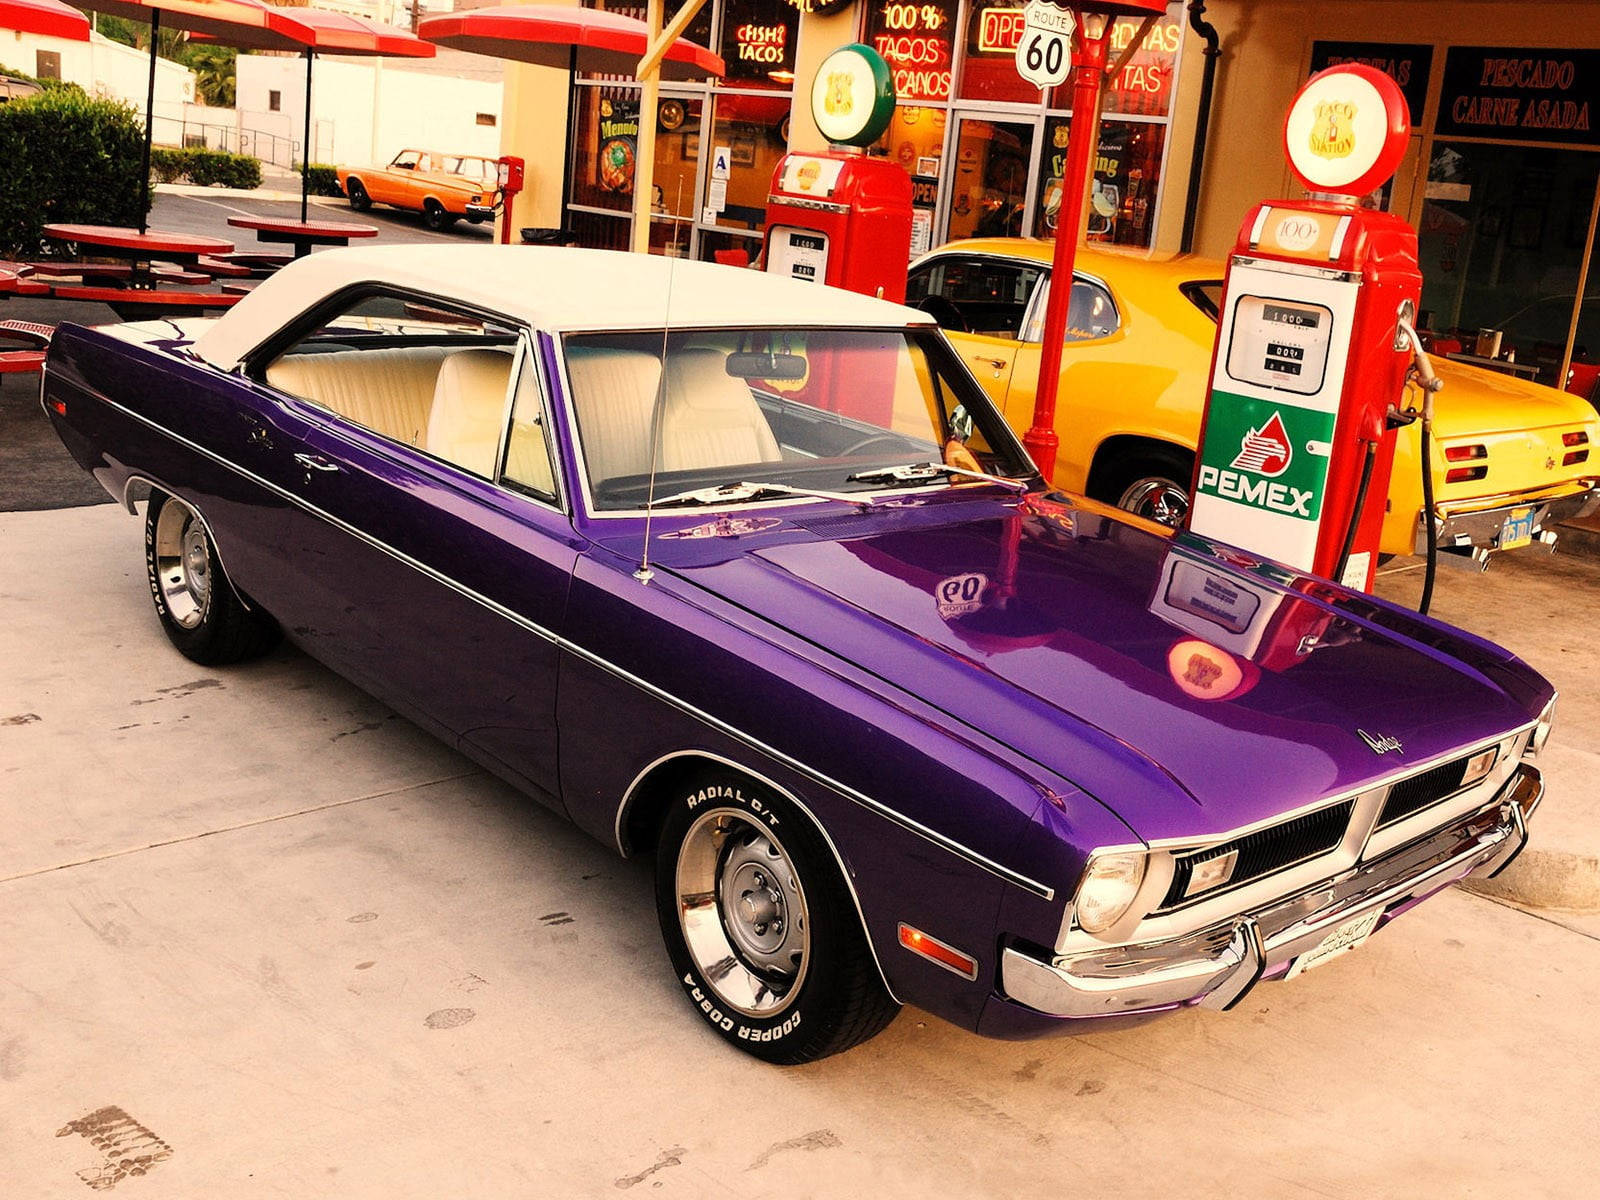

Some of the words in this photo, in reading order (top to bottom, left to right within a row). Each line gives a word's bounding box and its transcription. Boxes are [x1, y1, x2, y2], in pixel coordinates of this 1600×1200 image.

[884, 4, 917, 30] 100
[984, 14, 1024, 46] OPE
[1033, 10, 1068, 30] ROUTE
[738, 42, 784, 64] TACOS
[875, 36, 940, 64] TACOS
[1026, 34, 1064, 76] 60
[893, 69, 952, 96] CANOS
[1480, 58, 1575, 91] PESCADO
[1318, 104, 1354, 121] TACO
[1452, 95, 1520, 127] CARNE
[1521, 99, 1591, 131] ASADA
[1310, 132, 1353, 154] STATION
[716, 155, 727, 170] A
[1197, 464, 1314, 518] PEMEX
[686, 785, 746, 810] RADIAL
[750, 798, 780, 826] G/T
[684, 972, 735, 1032] COBRA
[738, 1009, 802, 1043] COOPER
